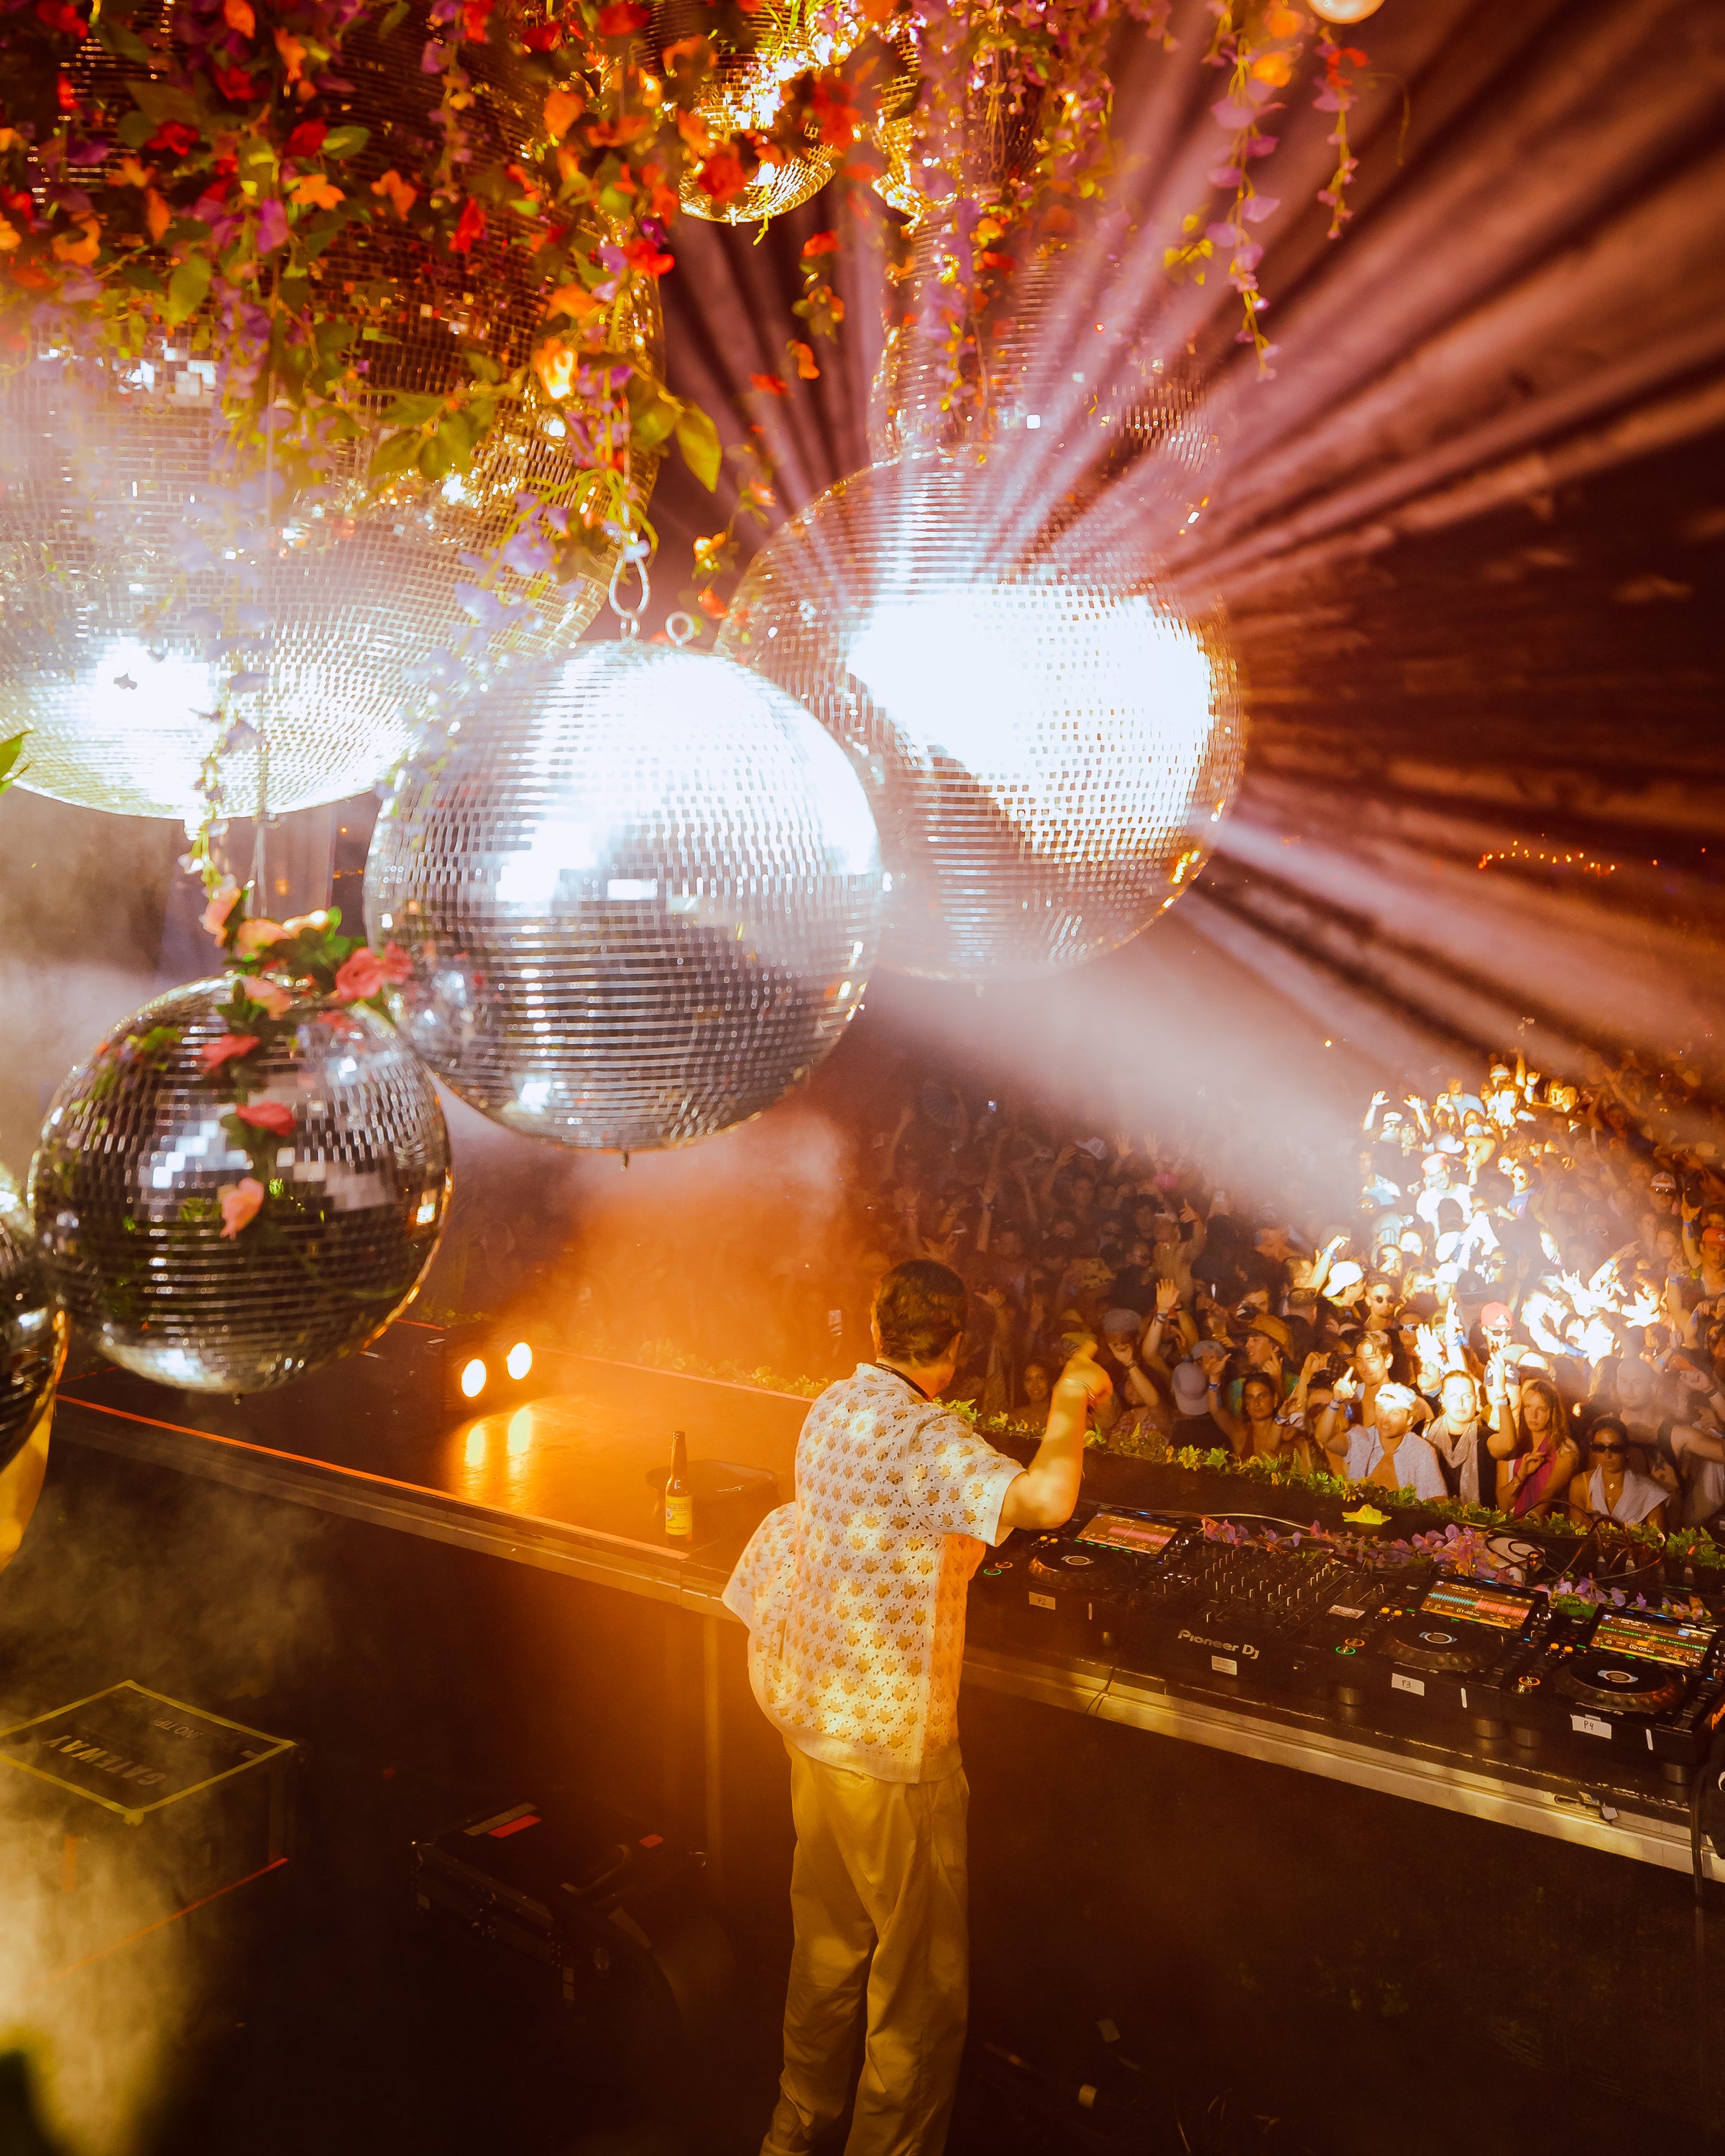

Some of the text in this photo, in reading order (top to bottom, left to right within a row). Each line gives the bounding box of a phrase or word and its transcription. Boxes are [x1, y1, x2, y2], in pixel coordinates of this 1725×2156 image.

[1177, 1629, 1239, 1651] Pioneer
[1402, 1679, 1412, 1688] P3
[1583, 1720, 1594, 1731] P4
[41, 1735, 166, 1785] GATEWAY
